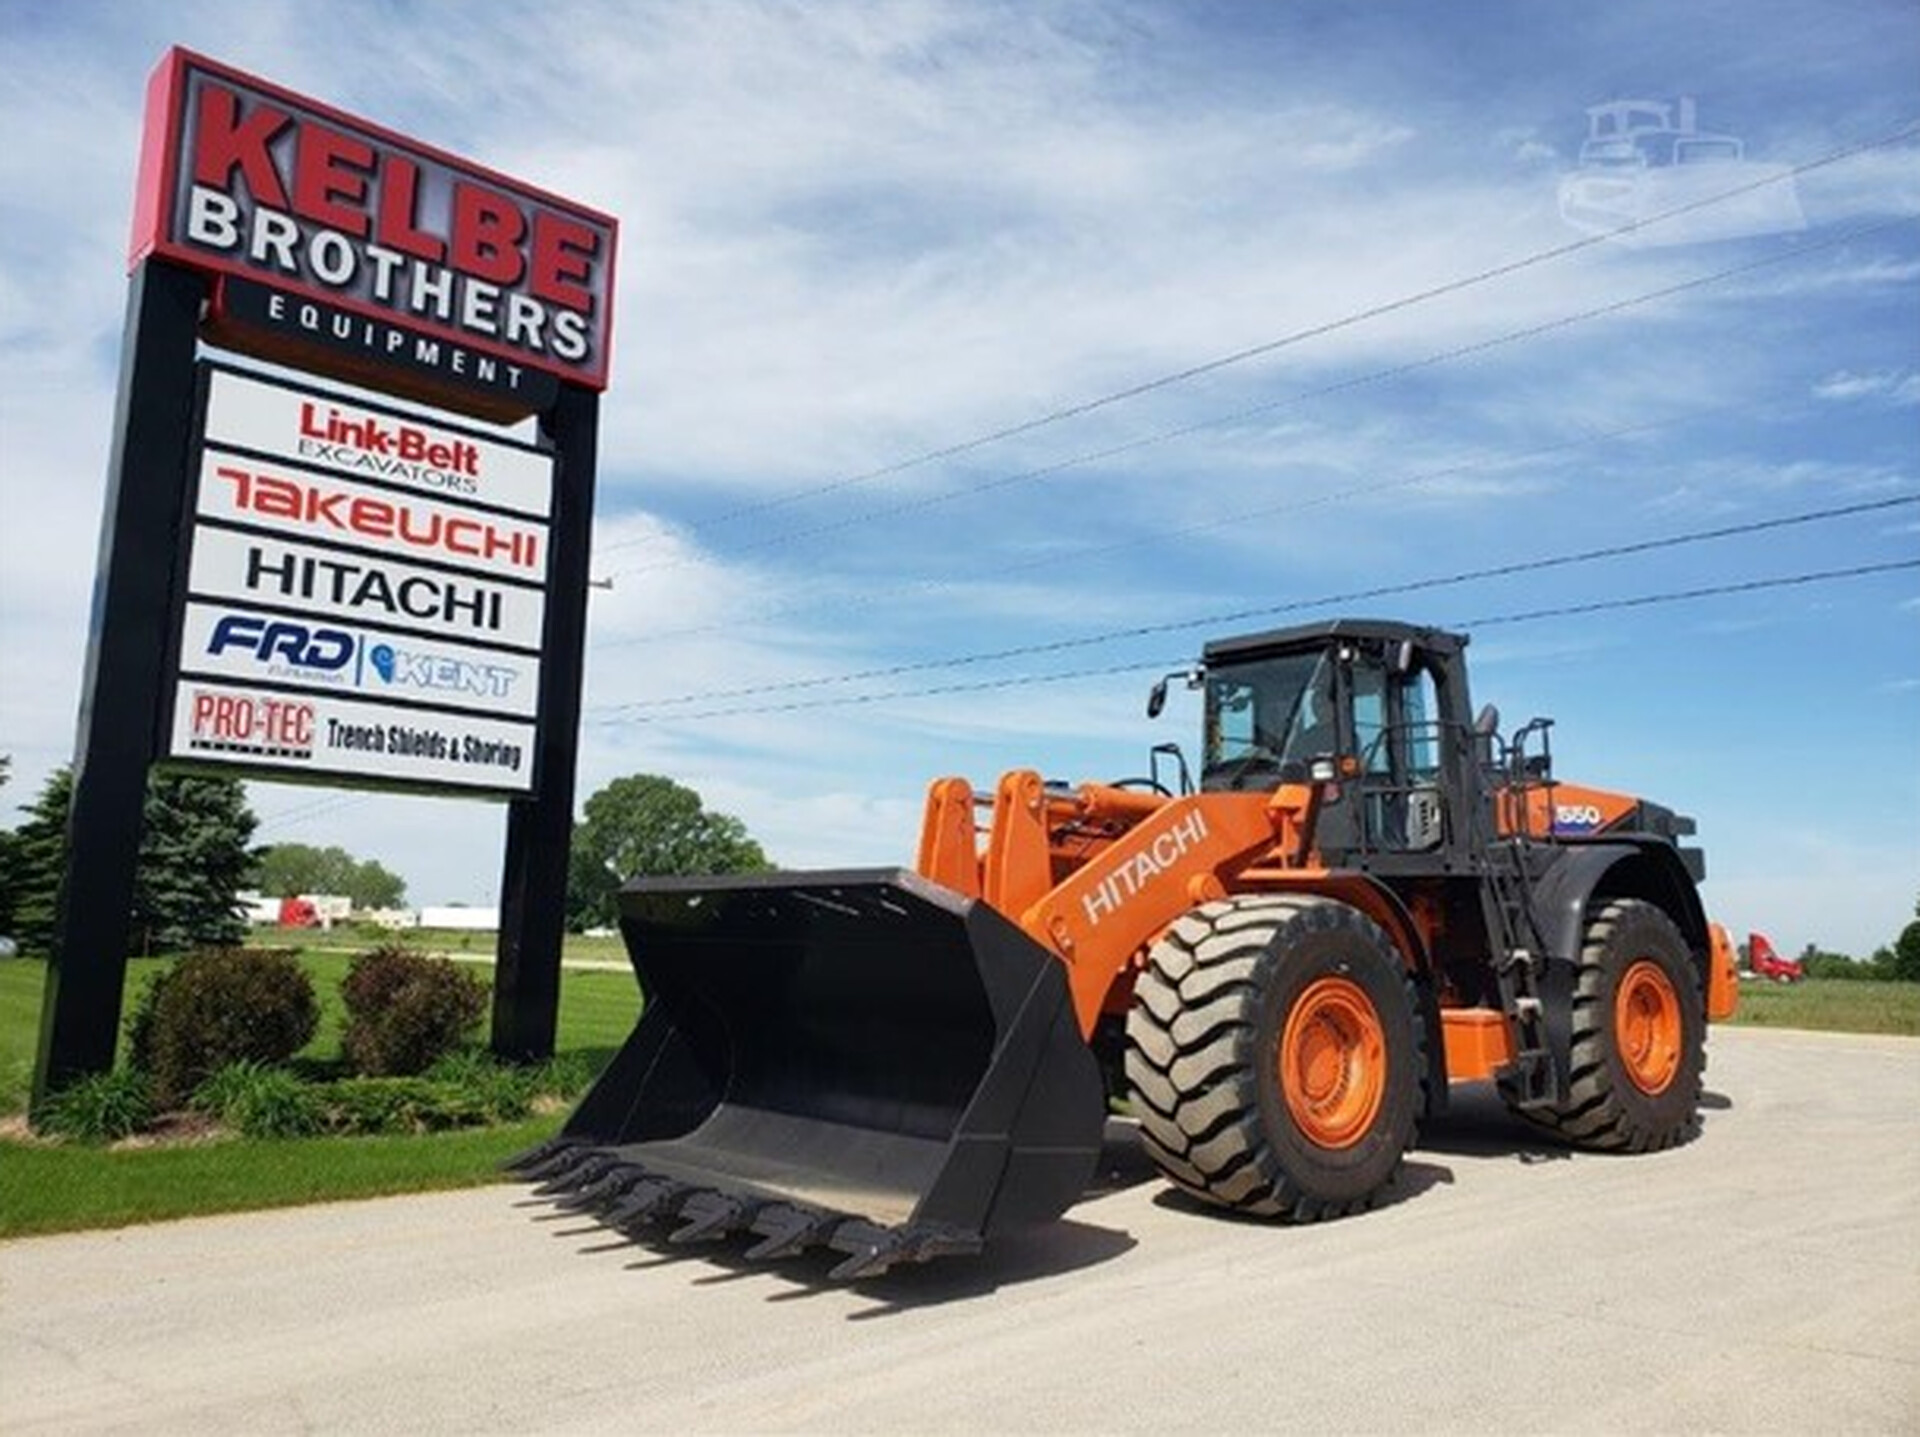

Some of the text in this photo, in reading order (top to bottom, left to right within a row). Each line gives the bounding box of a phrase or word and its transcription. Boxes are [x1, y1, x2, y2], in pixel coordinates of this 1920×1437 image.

[193, 87, 599, 312] KELBE
[187, 186, 588, 361] BROTHERS
[269, 295, 523, 390] EQUIPMENT
[298, 439, 479, 495] EXCAVATORS
[299, 402, 480, 476] Link-Belt
[246, 547, 502, 631] HITACHI
[206, 615, 356, 671] FRD
[396, 650, 518, 697] KENT
[193, 695, 314, 745] PRO-TEC
[327, 717, 385, 753] Trench
[387, 726, 448, 760] Shields
[1081, 808, 1209, 926] HITACHI
